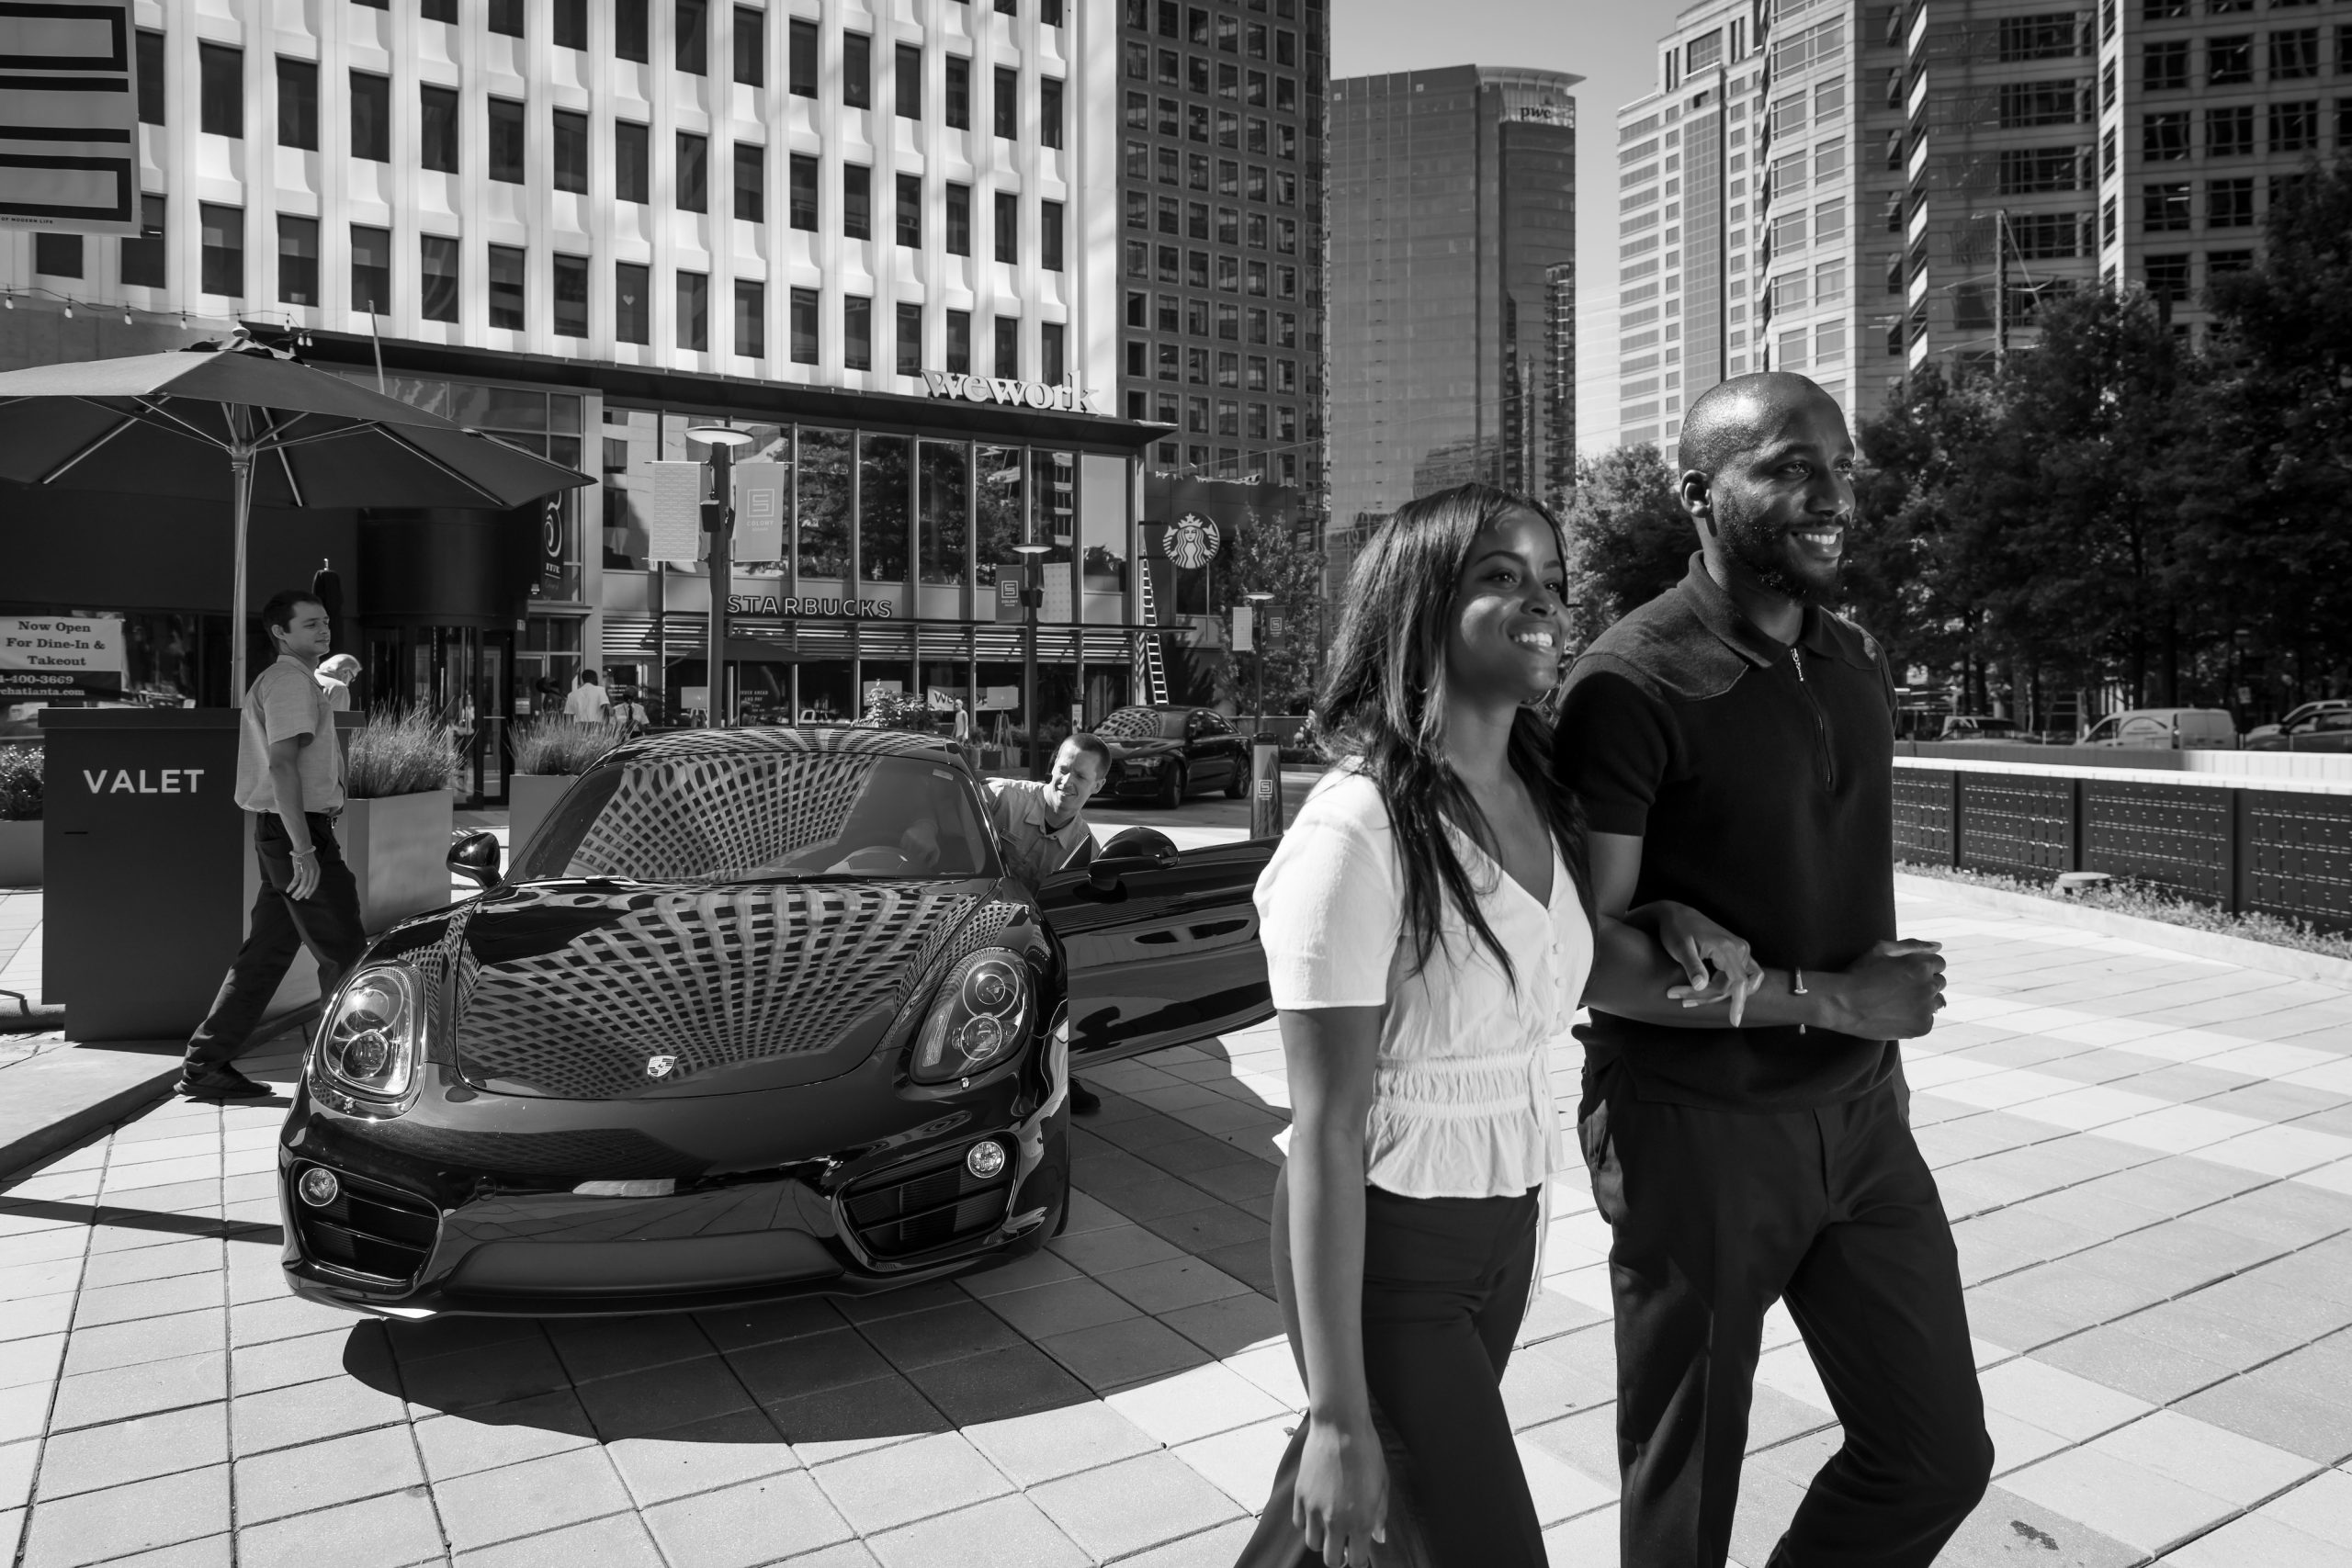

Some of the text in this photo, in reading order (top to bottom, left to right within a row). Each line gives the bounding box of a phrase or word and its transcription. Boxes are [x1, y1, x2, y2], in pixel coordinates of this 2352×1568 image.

[1521, 107, 1551, 120] pwc
[921, 369, 1102, 414] wework
[727, 595, 892, 618] STARBUCKS
[17, 620, 91, 634] Now Open
[6, 637, 106, 649] For Dine-In &
[27, 655, 86, 666] Takeout
[0, 687, 85, 696] chatlanta.com
[83, 769, 205, 794] VALET
